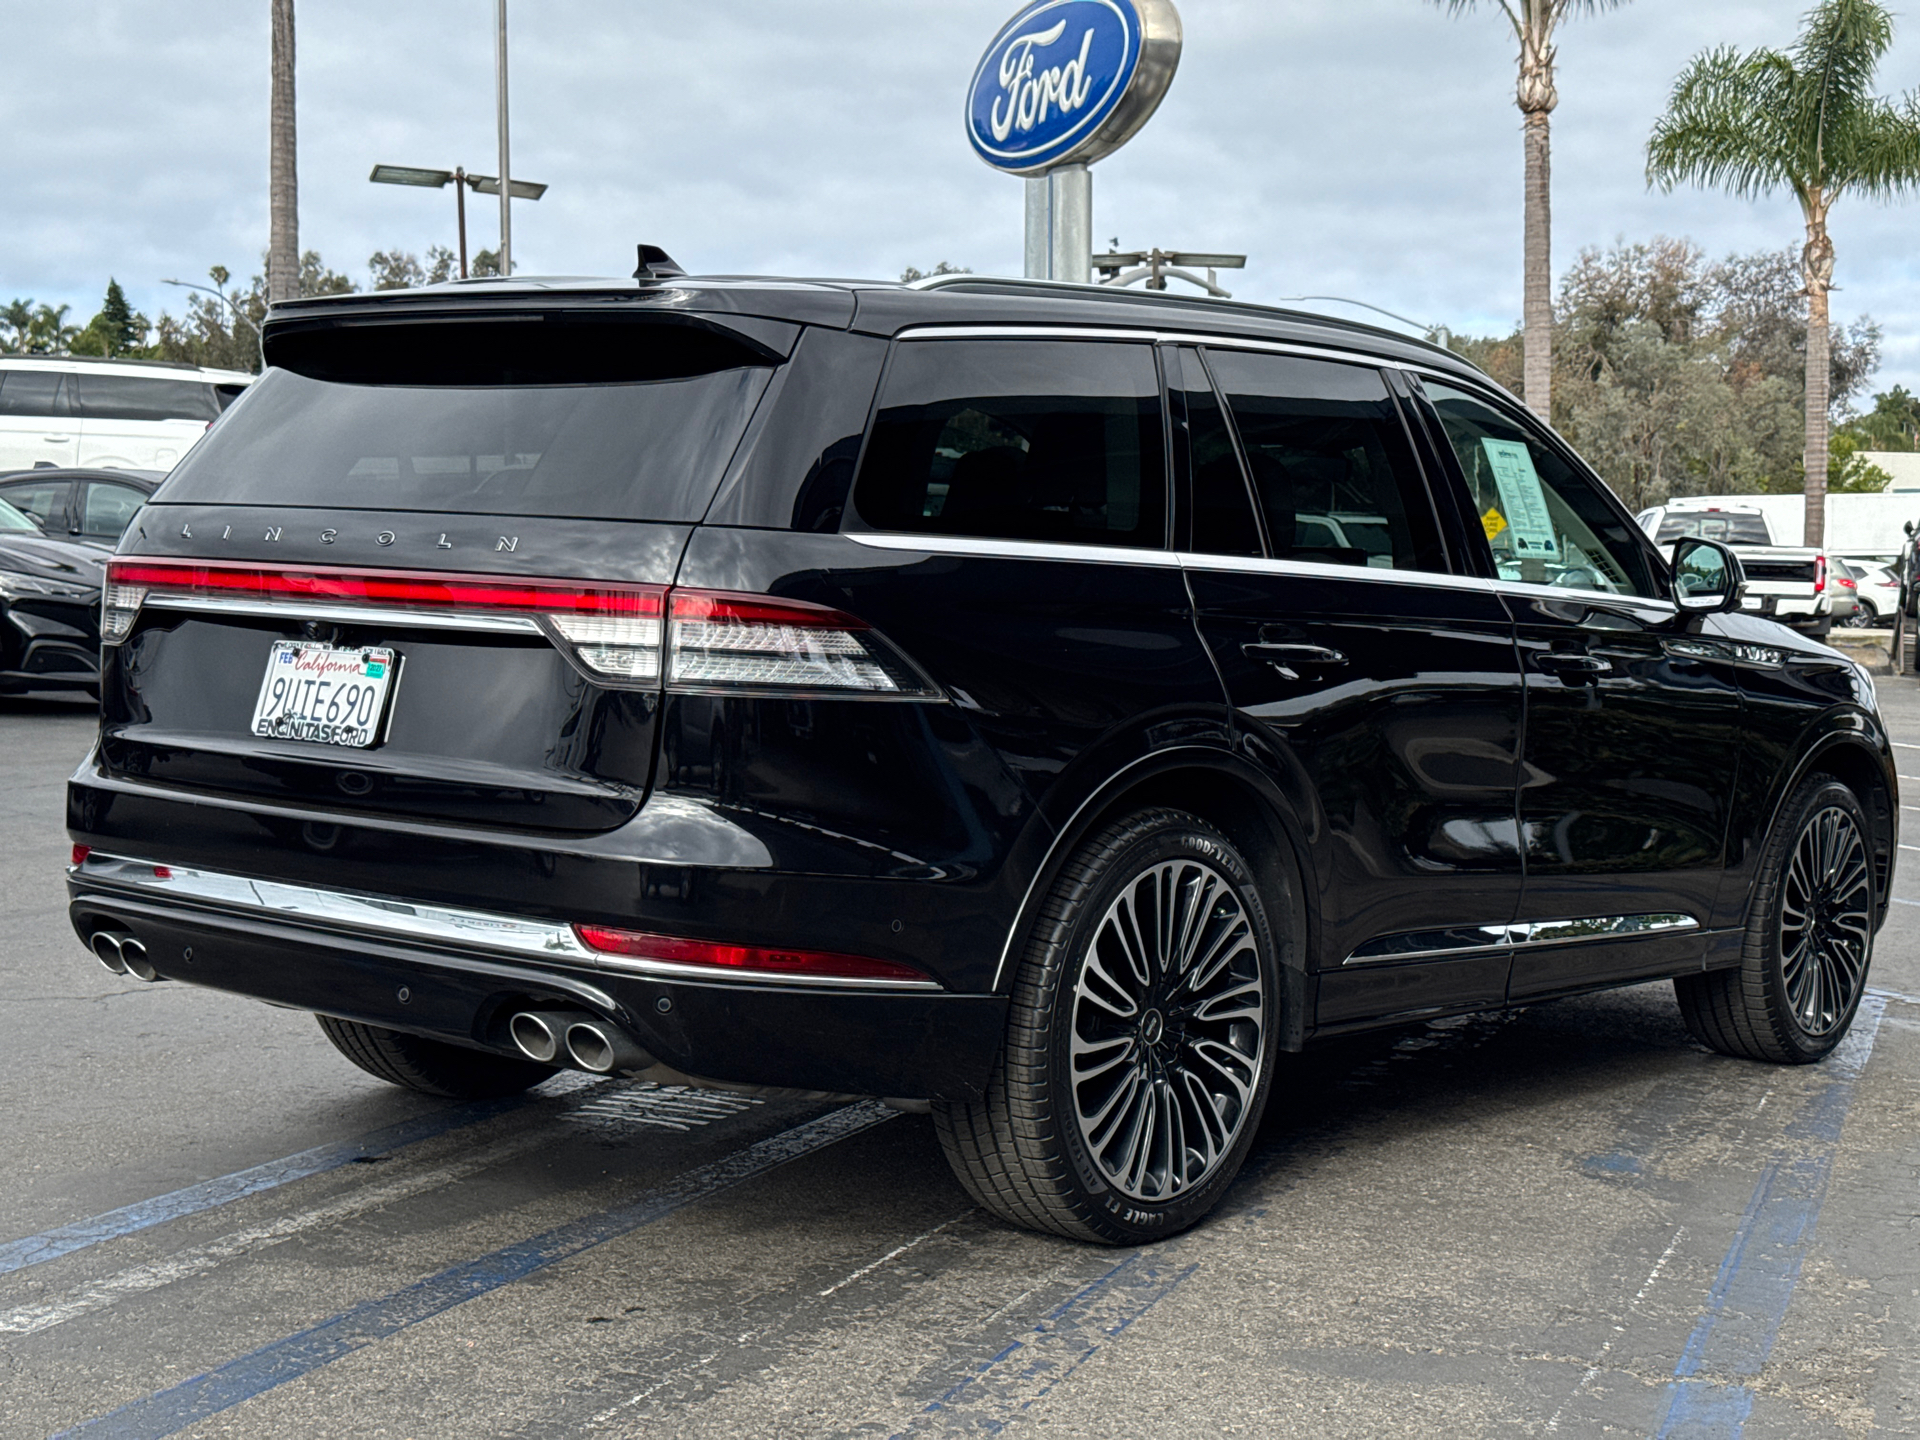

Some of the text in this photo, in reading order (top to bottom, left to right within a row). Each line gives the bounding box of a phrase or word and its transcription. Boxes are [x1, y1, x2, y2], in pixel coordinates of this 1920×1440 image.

[991, 19, 1095, 142] Ford
[181, 524, 519, 553] LINCOLN
[278, 652, 293, 664] FEB
[294, 650, 366, 679] California
[266, 677, 376, 727] 9UIE690
[331, 725, 369, 746] FORD
[1181, 836, 1244, 880] GOODYEAR
